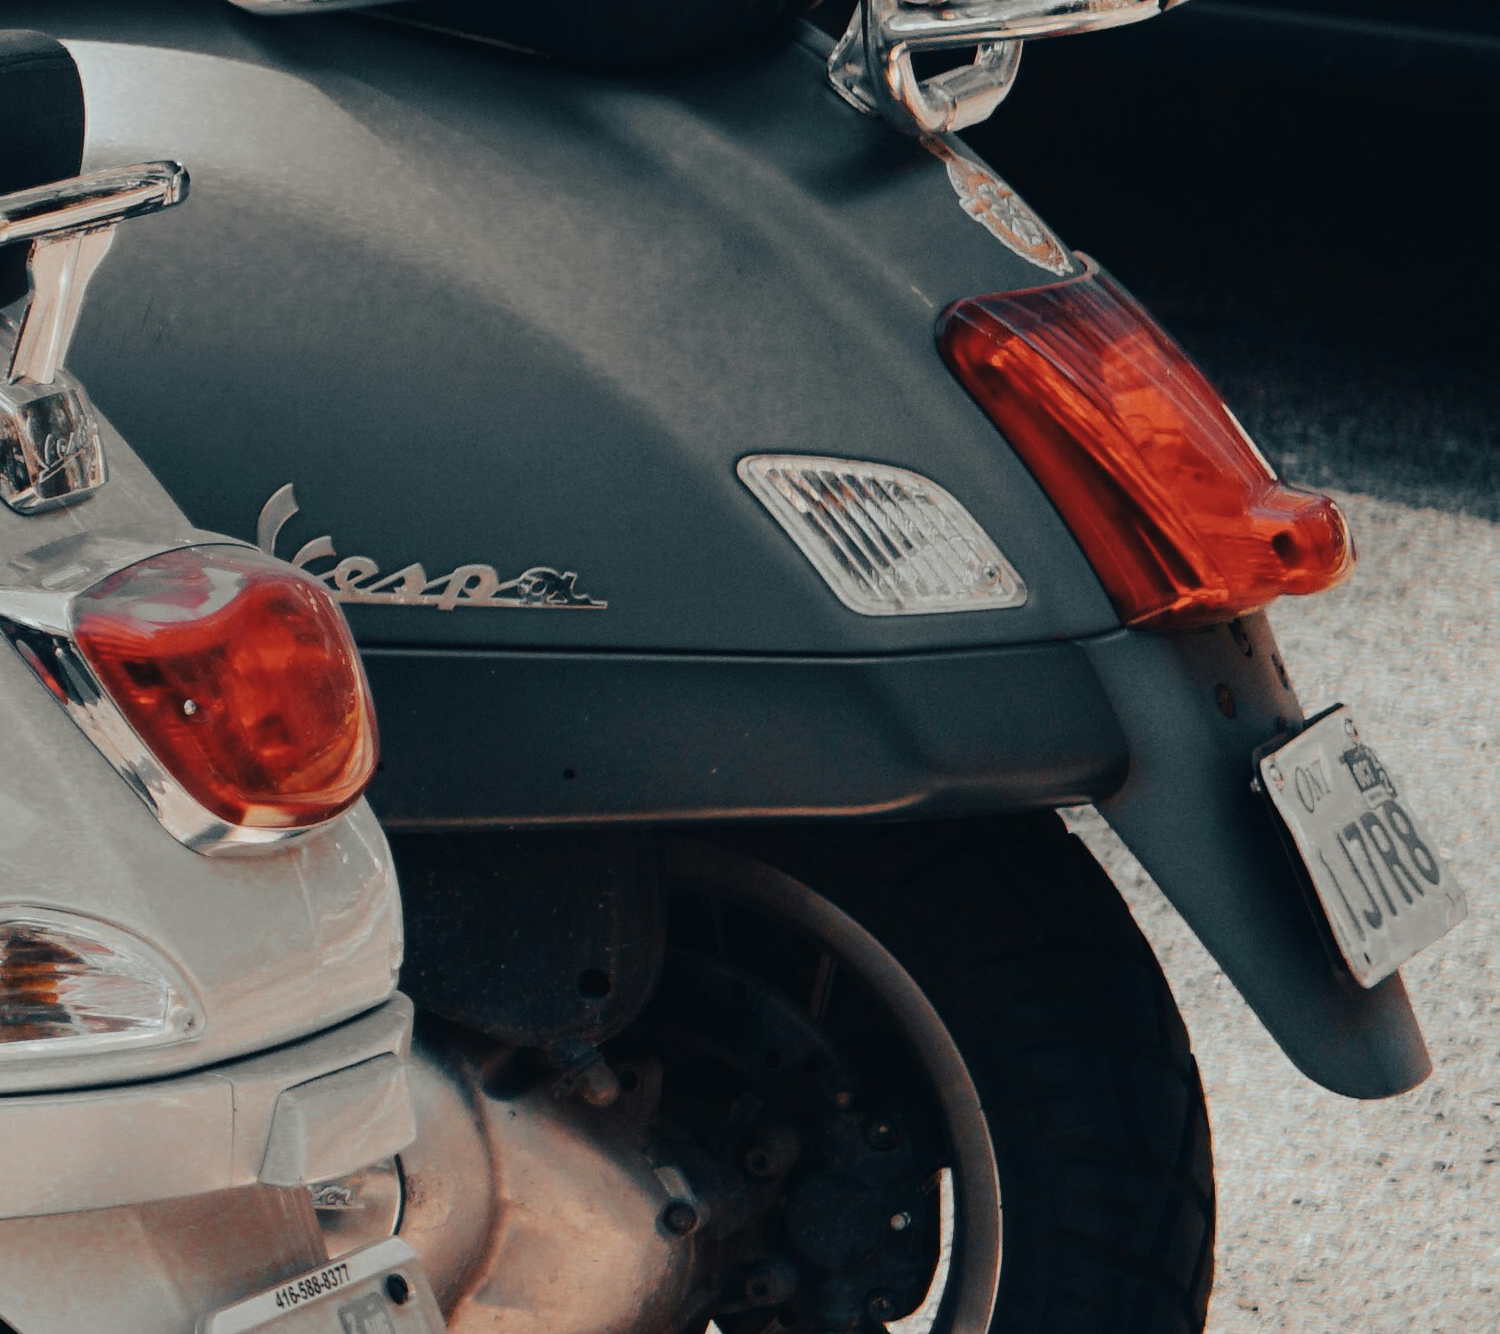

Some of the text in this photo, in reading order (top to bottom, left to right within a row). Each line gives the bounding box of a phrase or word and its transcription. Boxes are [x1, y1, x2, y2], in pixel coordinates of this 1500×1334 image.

[257, 482, 607, 611] Vespa
[1294, 759, 1331, 813] ONT
[1318, 800, 1441, 942] 1J7R8
[275, 1263, 351, 1309] 416-588-8377
